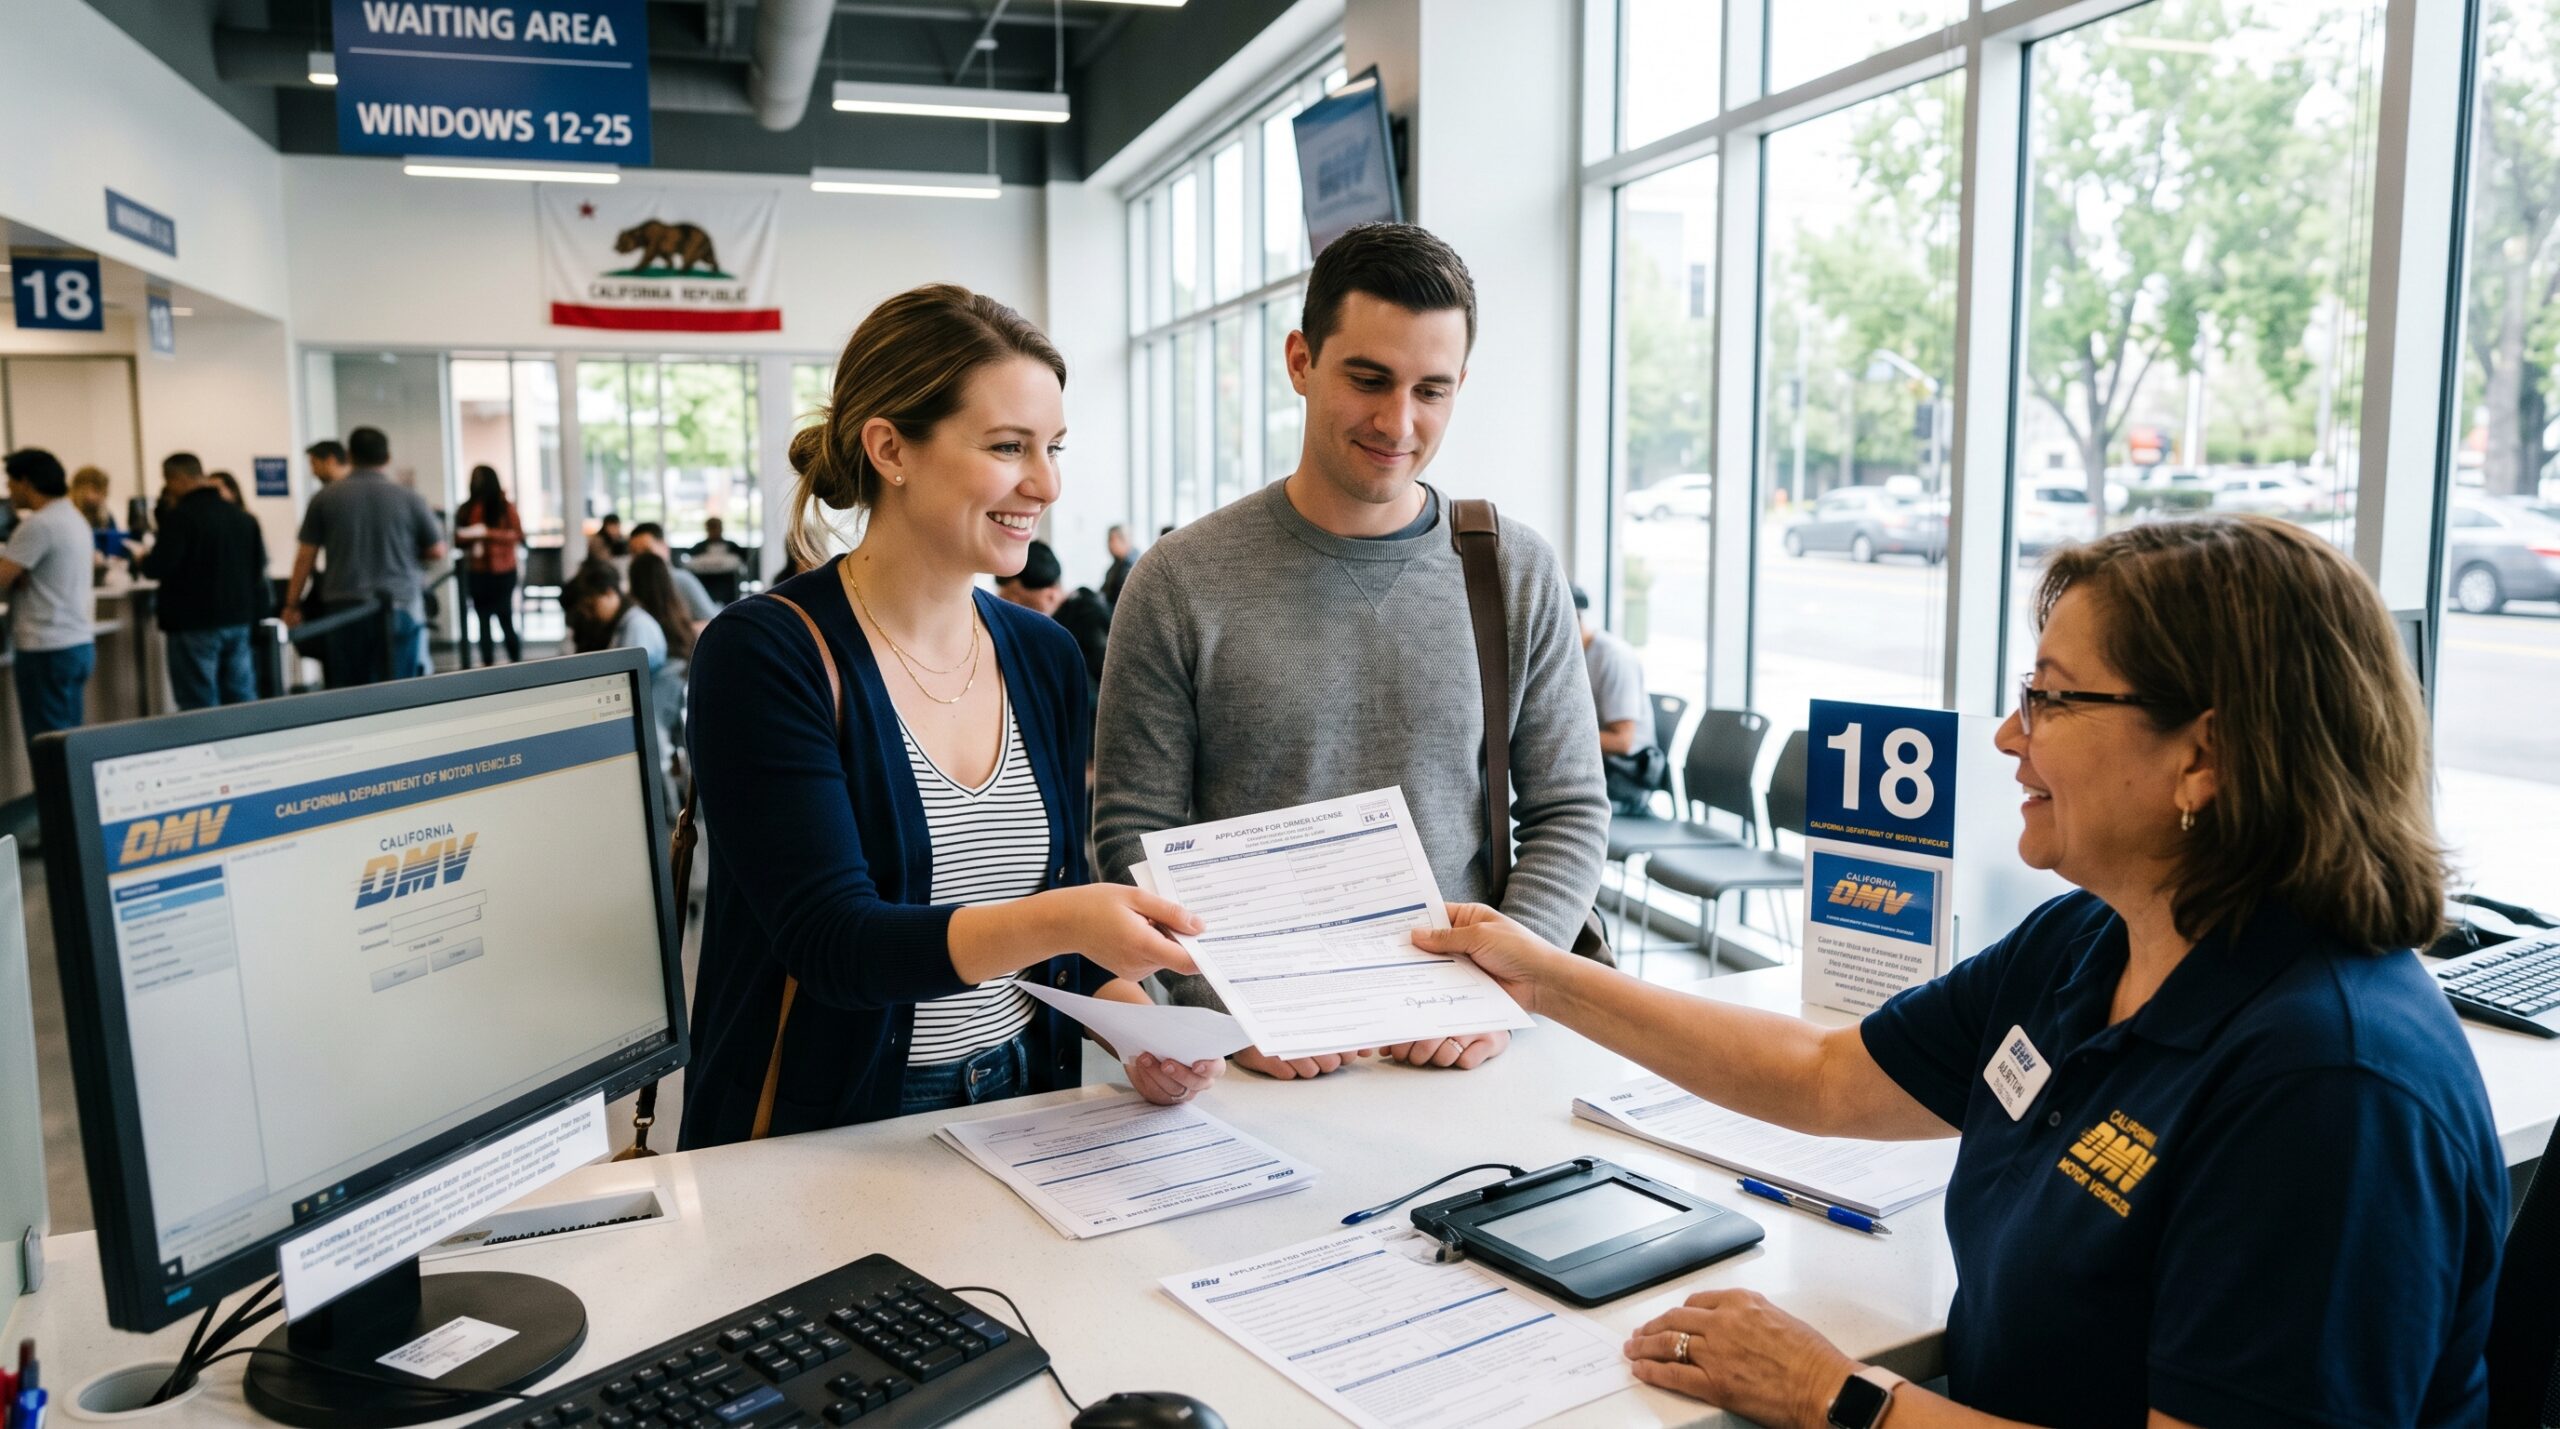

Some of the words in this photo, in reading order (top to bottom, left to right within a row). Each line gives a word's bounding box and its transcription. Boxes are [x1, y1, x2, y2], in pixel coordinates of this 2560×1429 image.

[362, 1, 515, 41] WAITING
[523, 10, 617, 47] AREA
[357, 102, 535, 142] WINDOWS
[544, 111, 633, 146] 12-25
[21, 269, 94, 322] 18
[588, 283, 672, 300] CALIFORNIA
[681, 285, 748, 303] REPUBLIC
[275, 790, 348, 819] CALIFORNIA
[349, 775, 421, 801] DEPARTMENT
[422, 772, 438, 786] OF
[439, 764, 474, 782] MOTOR
[1827, 722, 1935, 819] 18
[119, 804, 232, 865] DMV
[380, 823, 454, 851] CALIFORNIA
[1164, 839, 1196, 853] DMV
[1215, 826, 1265, 842] APPLICATION
[1265, 822, 1281, 833] FOR
[1312, 810, 1344, 824] LICENSE
[354, 831, 479, 910] DMV
[1846, 872, 1897, 889] CALIFORNIA
[1828, 879, 1914, 916] DMV
[2057, 1156, 2091, 1187] MOTOR
[2068, 1121, 2158, 1194] DMV
